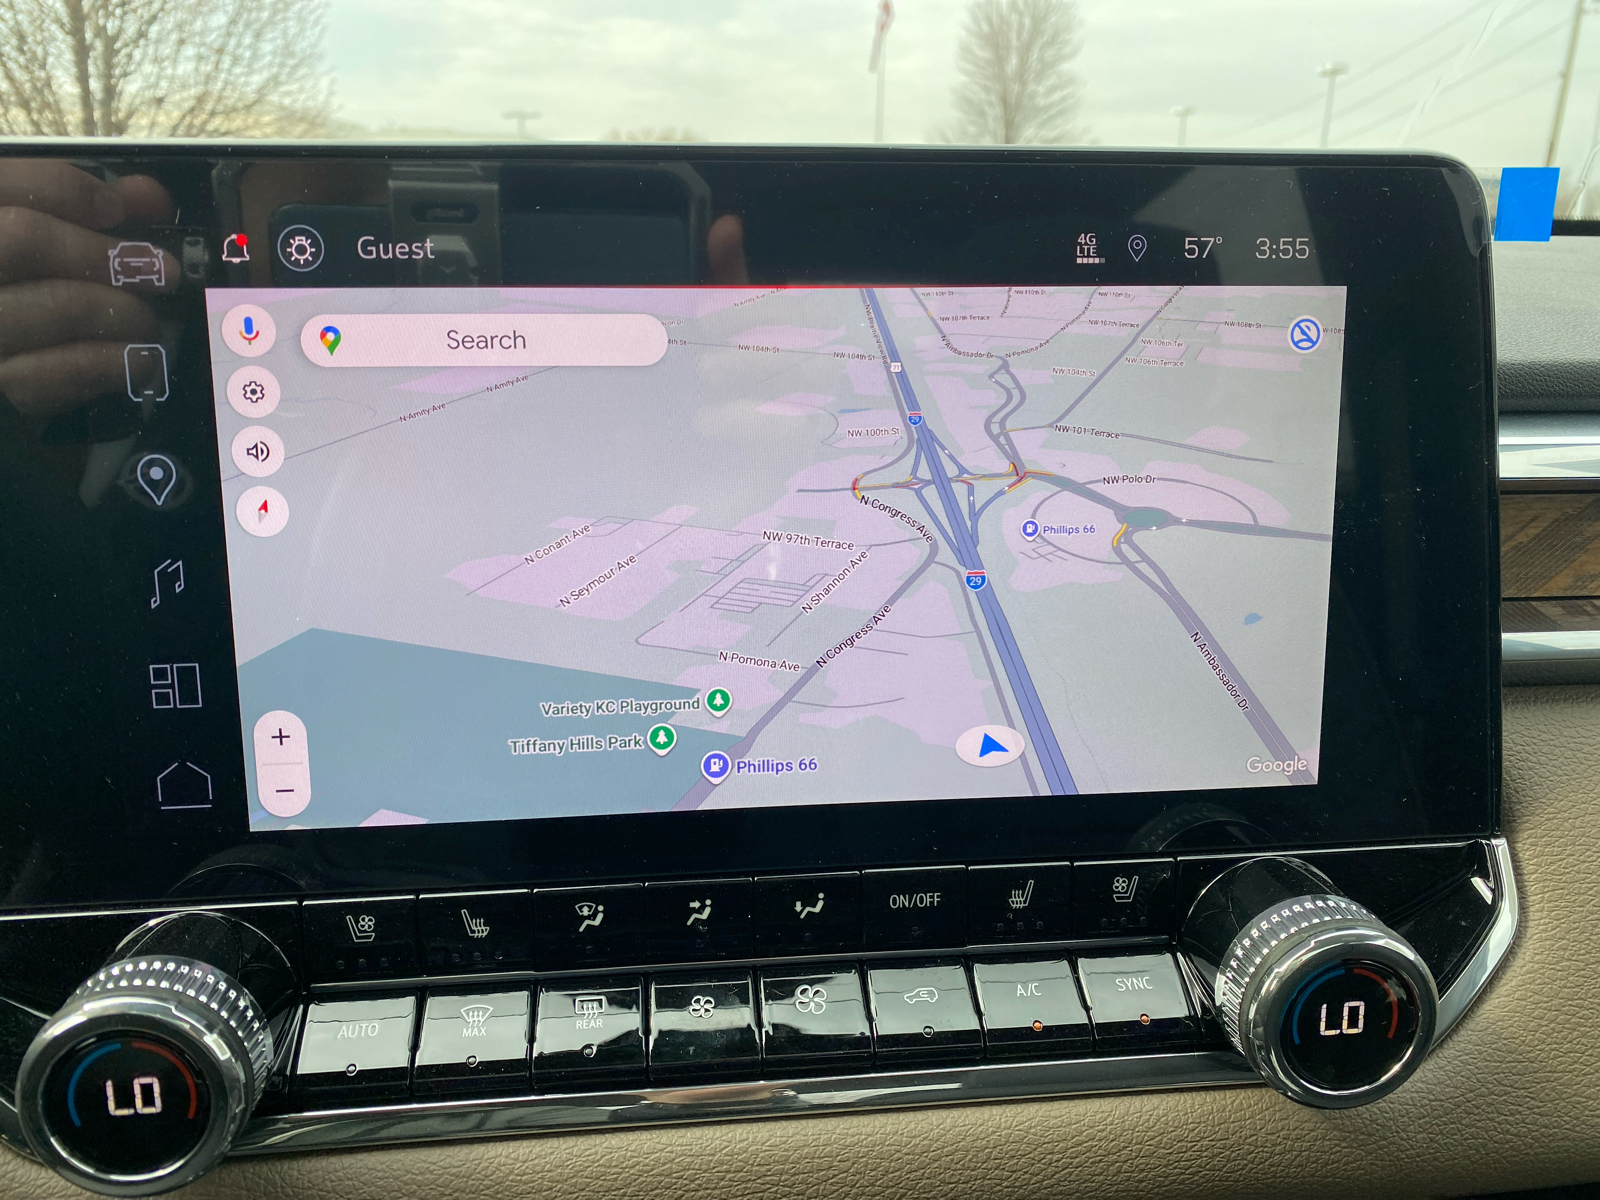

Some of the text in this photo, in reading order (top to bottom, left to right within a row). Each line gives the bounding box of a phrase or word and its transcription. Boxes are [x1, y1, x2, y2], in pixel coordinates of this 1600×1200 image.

[357, 236, 435, 260] Guest
[1077, 233, 1096, 245] 4G
[1184, 237, 1223, 259] 57°
[1255, 237, 1309, 259] 3:55
[1076, 245, 1097, 256] LTE
[446, 329, 527, 350] Search
[1012, 346, 1039, 357] Pomona
[1040, 339, 1050, 348] Ave
[848, 352, 866, 360] 104th
[945, 342, 986, 358] Ambassador
[1052, 367, 1064, 375] NW
[1067, 368, 1087, 376] 104th
[494, 380, 514, 391] Amity
[516, 374, 529, 383] Ave
[408, 408, 430, 420] Amity
[432, 402, 446, 412] Ave
[848, 427, 900, 438] NW 100th St
[1054, 424, 1121, 440] NW 101 Terrace
[1103, 474, 1156, 485] NW Polo Dr
[860, 496, 934, 543] N Congress Ave
[1043, 524, 1096, 536] Phillips 66
[524, 524, 592, 566] N Conant Ave
[762, 530, 855, 551] NW 97th Terrace
[559, 554, 637, 608] N Seymour Ave
[802, 550, 868, 614] N Shannon Ave
[970, 576, 982, 586] 29
[816, 604, 892, 668] N Congress Ave
[719, 652, 800, 672] N Pomona Ave
[1190, 632, 1250, 712] N Ambassador Dr
[541, 698, 700, 717] Variety KC Playground
[510, 735, 643, 754] Tiffany Hills Park
[736, 758, 818, 776] Phillips 66
[1246, 755, 1308, 776] Google
[889, 892, 942, 909] ON/OFF
[1016, 982, 1042, 998] A/C
[1115, 976, 1154, 992] SYNC
[575, 1018, 604, 1030] REAR
[1319, 1000, 1366, 1036] LO
[336, 1022, 380, 1039] AUTO
[462, 1026, 488, 1038] MAX
[105, 1076, 162, 1116] LO
